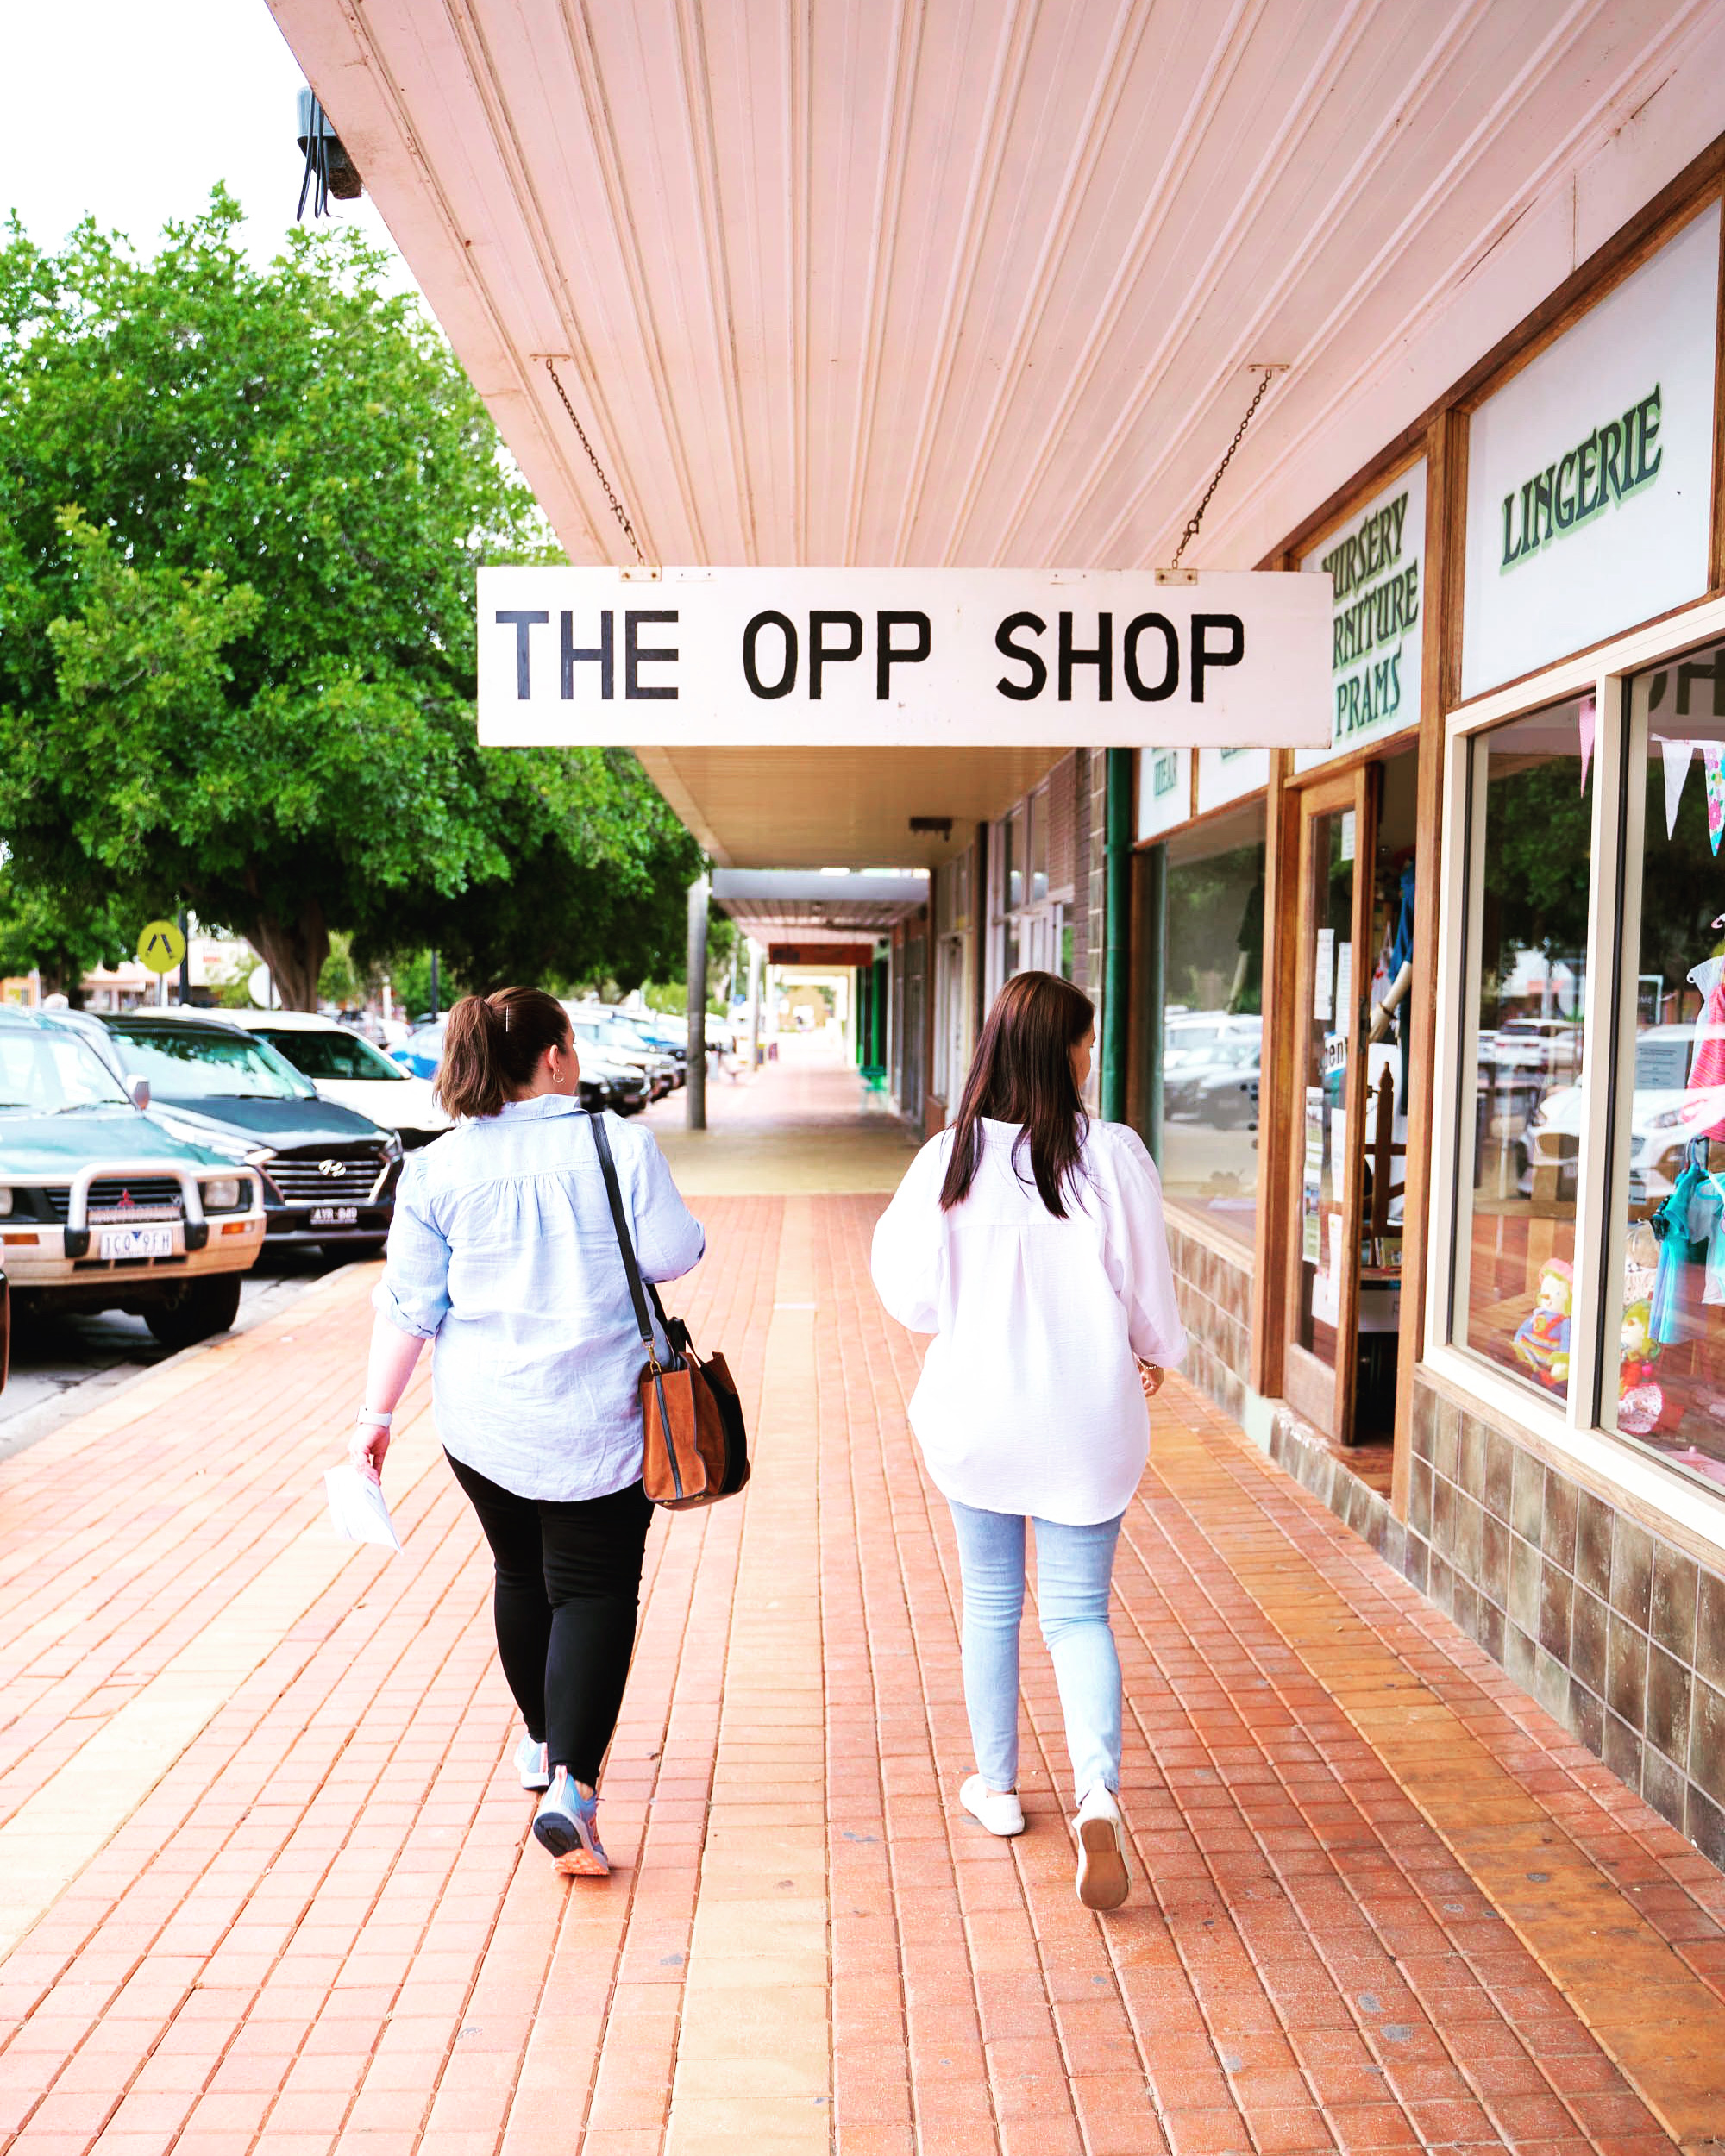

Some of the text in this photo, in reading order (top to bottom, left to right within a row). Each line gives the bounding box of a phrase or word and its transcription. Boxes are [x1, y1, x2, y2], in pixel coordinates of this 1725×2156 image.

[1501, 382, 1663, 569] LINGERIE
[495, 610, 1245, 705] THE OPP SHOP
[1333, 557, 1419, 670] RNITURE
[1335, 642, 1402, 737] PRAMS
